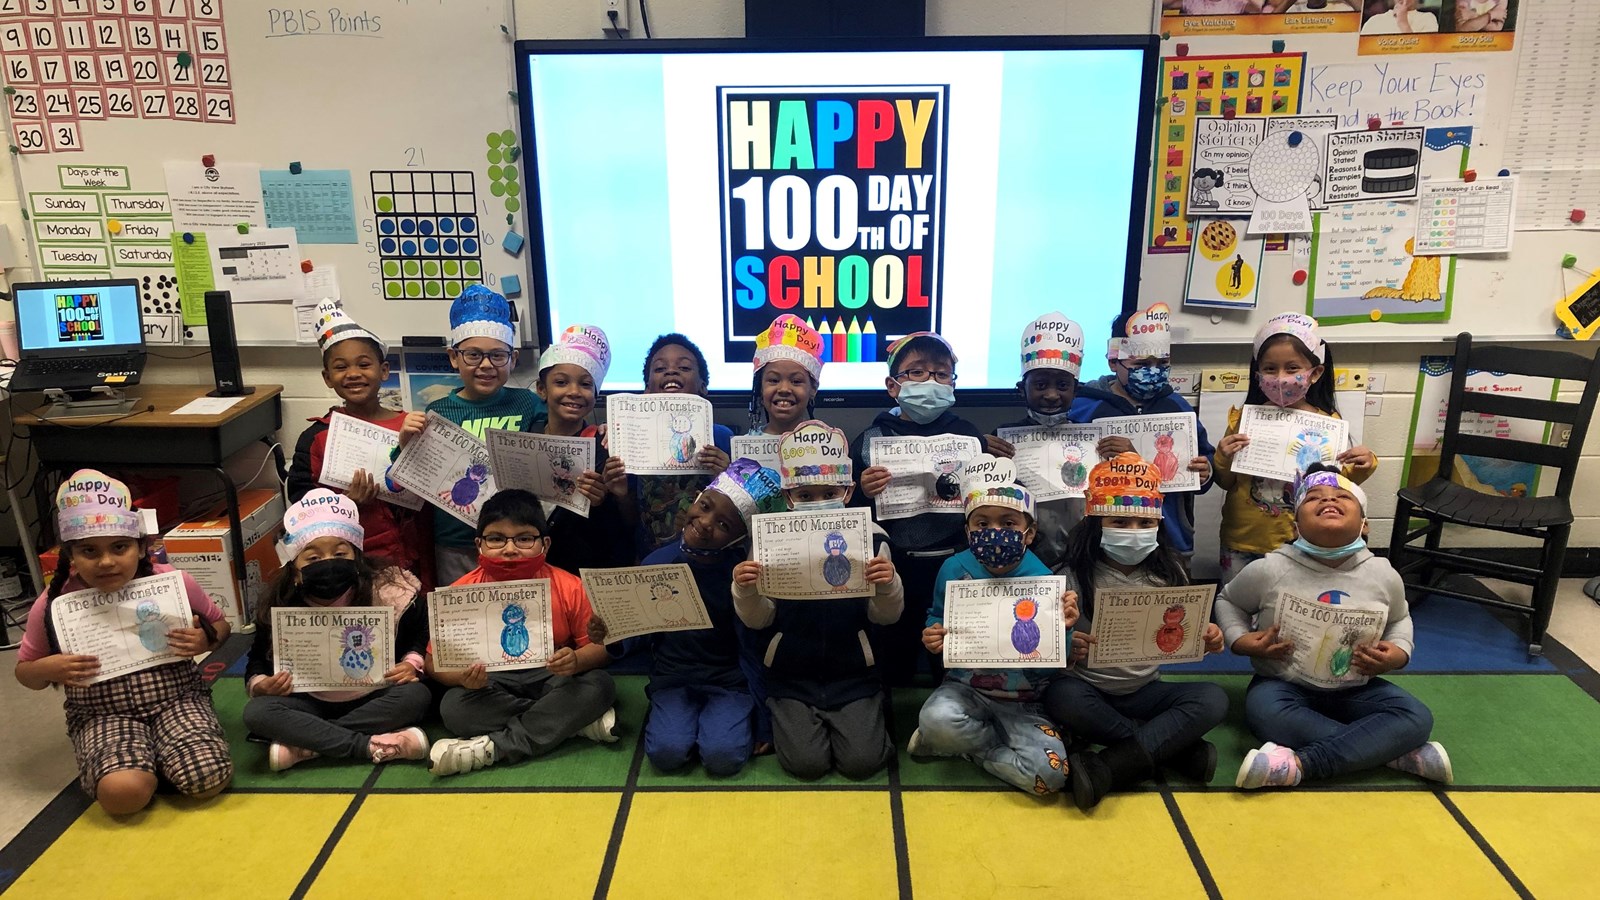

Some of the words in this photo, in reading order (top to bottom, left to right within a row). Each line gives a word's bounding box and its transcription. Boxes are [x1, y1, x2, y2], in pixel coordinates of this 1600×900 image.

[269, 8, 321, 33] PBIS
[328, 8, 381, 33] Points
[1202, 18, 1236, 27] Watching
[7, 29, 20, 47] 9
[35, 28, 50, 46] 10
[70, 27, 84, 45] 11
[100, 26, 116, 44] 12
[136, 27, 151, 45] 13
[166, 29, 180, 48] 14
[203, 32, 218, 50] 15
[1458, 36, 1478, 45] Body
[12, 61, 27, 78] 16
[44, 62, 58, 79] 17
[75, 61, 90, 79] 18
[107, 60, 123, 78] 19
[133, 62, 157, 79] 20
[175, 63, 189, 81] 21
[204, 65, 227, 82] 22
[1310, 65, 1363, 106] Keep
[1374, 62, 1421, 95] Your
[1430, 62, 1485, 96] Eyes
[14, 95, 37, 113] 23
[47, 94, 69, 112] 24
[78, 97, 101, 114] 25
[109, 94, 132, 112] 26
[144, 95, 165, 113] 27
[175, 97, 198, 115] 28
[208, 99, 231, 117] 29
[1388, 106, 1410, 121] the
[1414, 95, 1475, 122] Book!
[730, 100, 936, 169] HAPPY
[1208, 120, 1256, 135] Opinion
[20, 131, 42, 147] 30
[60, 128, 73, 145] 31
[1332, 134, 1372, 147] Opinion
[1377, 130, 1421, 141] Stories
[405, 148, 425, 167] 21
[68, 167, 89, 177] Days
[91, 168, 100, 176] of
[104, 168, 119, 177] the
[868, 175, 933, 211] DAY
[1332, 184, 1357, 192] Opinion
[45, 198, 86, 210] Sunday
[111, 198, 164, 210] Thursday
[47, 225, 91, 237] Monday
[125, 225, 159, 237] Friday
[890, 214, 929, 250] OF
[51, 250, 98, 263] Tuesday
[120, 249, 172, 261] Saturday
[735, 254, 929, 309] SCHOOL
[57, 296, 97, 307] HAPPY
[1268, 314, 1302, 323] Happy
[60, 321, 100, 332] SCHOOL
[774, 320, 809, 335] Happy
[1034, 321, 1069, 332] Happy
[583, 328, 608, 353] Happy
[796, 335, 820, 351] Day!
[1057, 333, 1081, 347] Day!
[97, 370, 137, 378] Sexton
[618, 401, 637, 412] The
[639, 401, 656, 412] 100
[659, 400, 702, 413] Monster
[461, 415, 522, 441] NIKE
[1254, 411, 1272, 421] The
[1274, 412, 1292, 422] 100
[1294, 414, 1337, 431] Monster
[794, 432, 832, 444] Happy
[822, 446, 845, 458] Day!
[882, 444, 901, 456] The
[903, 443, 922, 455] 100
[924, 441, 969, 453] Monster
[964, 461, 997, 476] Happy
[1110, 462, 1148, 476] Happy
[984, 471, 1011, 483] Day!
[1136, 477, 1158, 490] Day!
[68, 480, 110, 493] Happy
[97, 494, 127, 508] Day!
[300, 495, 340, 508] Happy
[331, 505, 356, 520] Day!
[765, 521, 786, 534] The
[789, 520, 807, 533] 100
[811, 518, 859, 531] Monster
[593, 575, 612, 586] The
[614, 574, 632, 585] 100
[634, 571, 679, 584] Monster
[65, 600, 90, 614] The
[91, 594, 114, 608] 100
[117, 584, 170, 601] Monster
[441, 594, 464, 606] The
[465, 592, 486, 604] 100
[488, 589, 537, 602] Monster
[958, 586, 979, 599] The
[981, 585, 1000, 597] 100
[1001, 585, 1052, 597] Monster
[1109, 596, 1130, 607] The
[1132, 595, 1151, 606] 100
[1152, 593, 1202, 605] Monster
[1289, 600, 1309, 616] The
[1310, 608, 1329, 622] 100
[1332, 613, 1376, 626] Monster
[285, 615, 308, 627] The
[310, 616, 330, 626] 100
[332, 615, 381, 627] Monster
